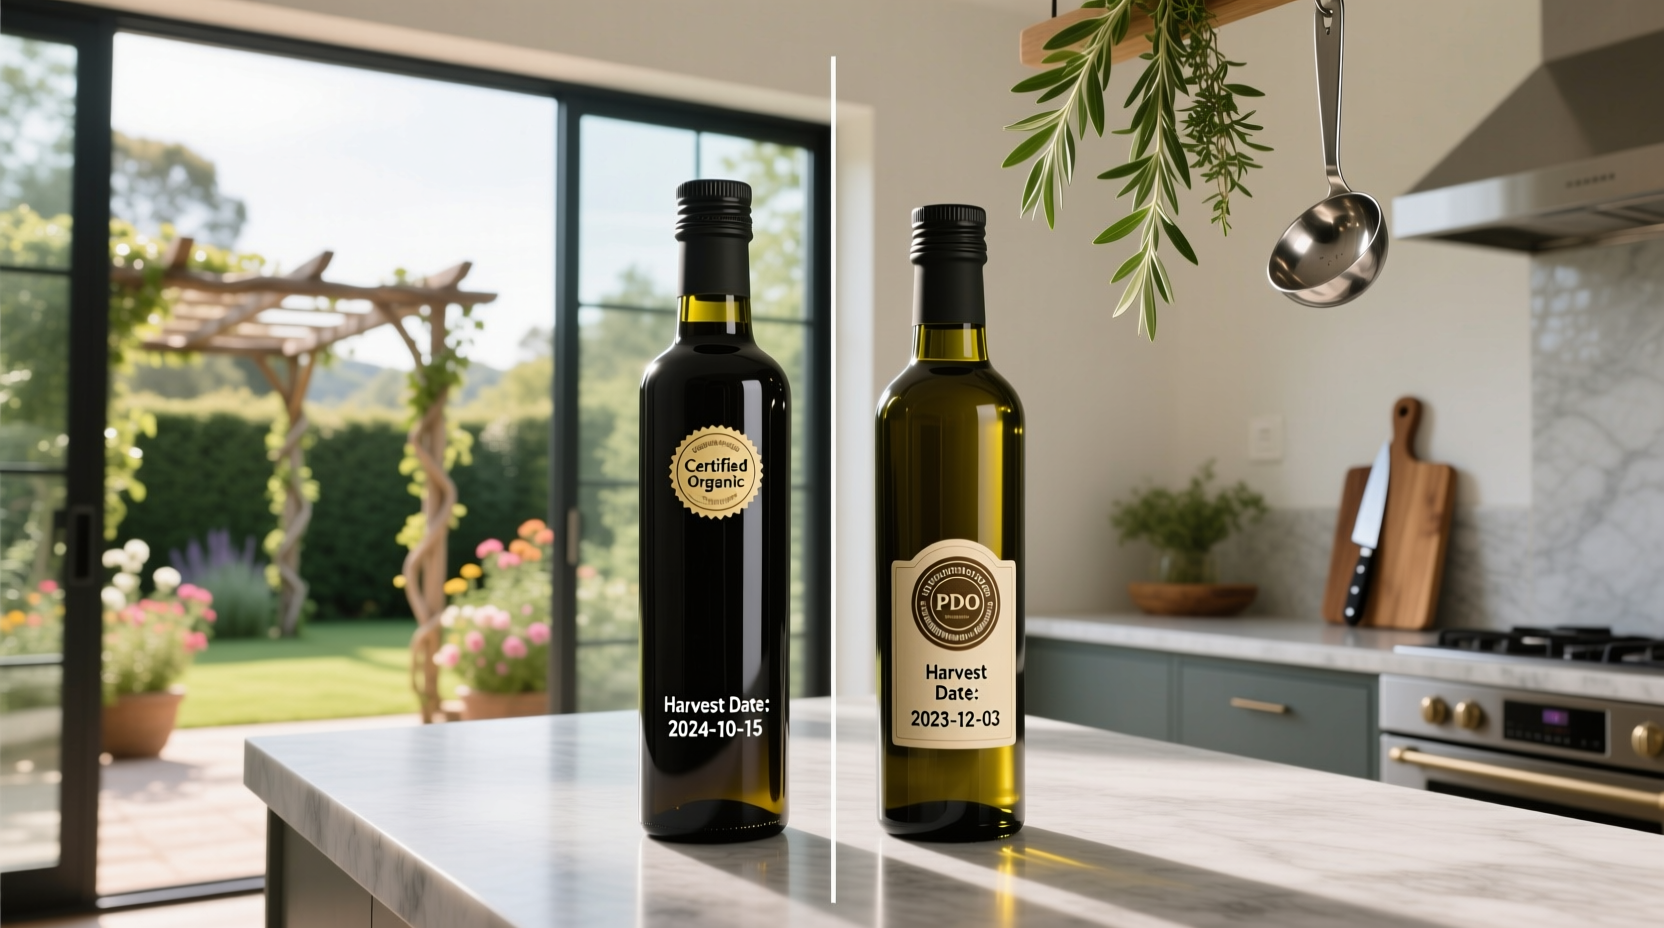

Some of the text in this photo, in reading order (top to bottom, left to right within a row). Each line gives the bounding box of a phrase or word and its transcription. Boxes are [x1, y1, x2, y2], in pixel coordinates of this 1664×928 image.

[684, 457, 748, 473] Certified
[687, 475, 745, 492] Organic
[936, 593, 980, 611] PDO
[926, 664, 988, 680] Harvest
[935, 685, 979, 701] Date:
[664, 695, 770, 713] Harvest Date:
[911, 709, 1001, 728] 2023-12-03
[668, 718, 763, 738] 2024-10-15
